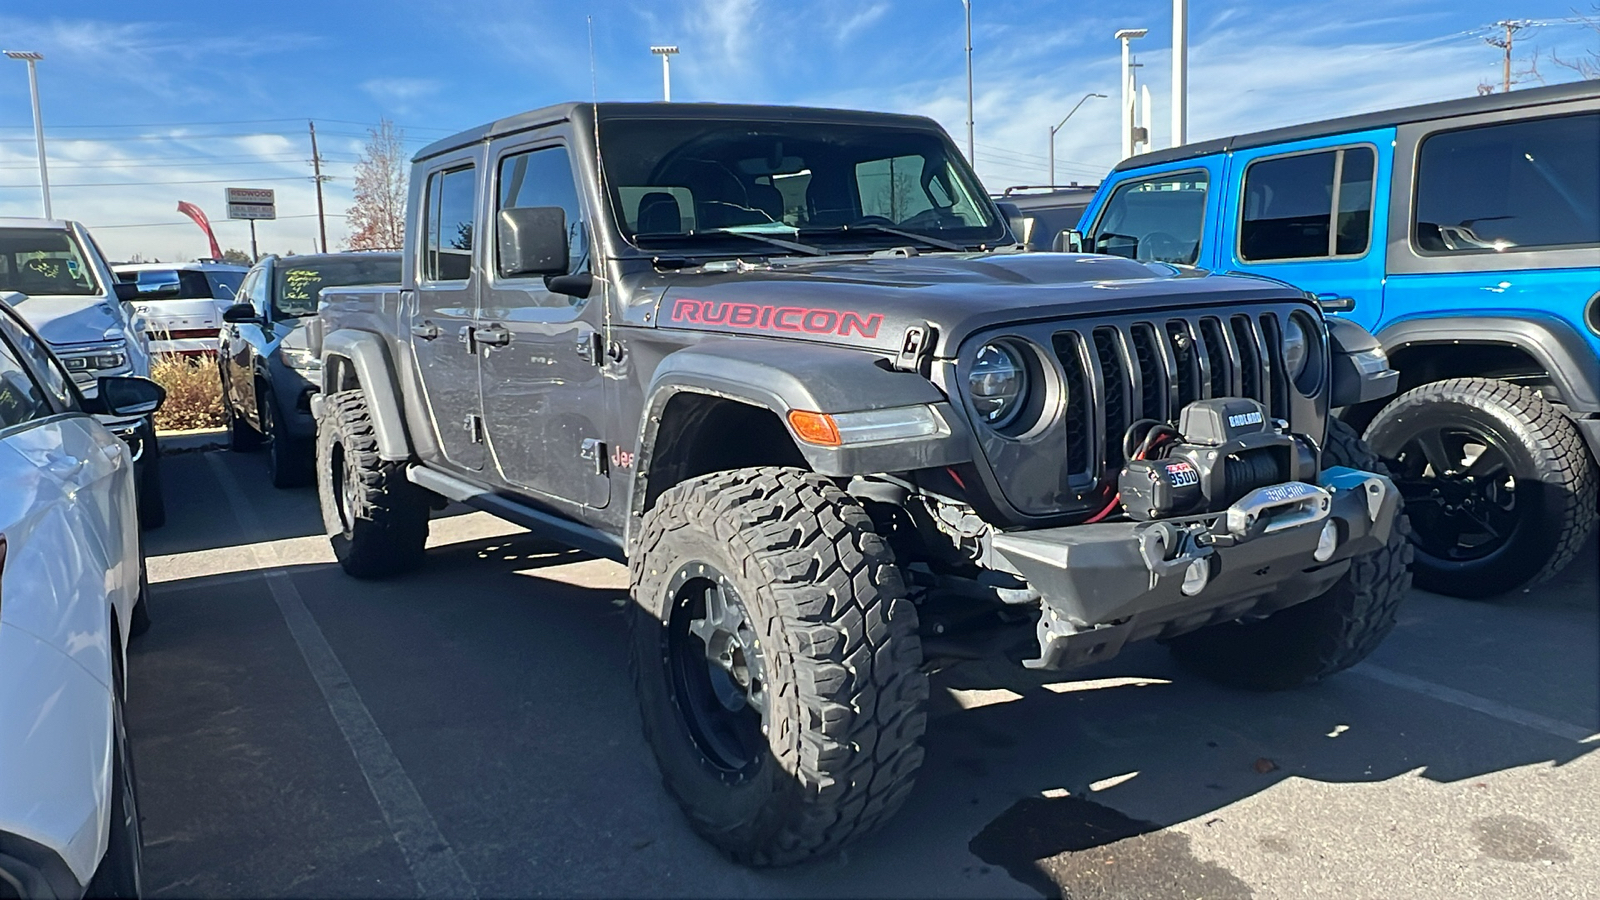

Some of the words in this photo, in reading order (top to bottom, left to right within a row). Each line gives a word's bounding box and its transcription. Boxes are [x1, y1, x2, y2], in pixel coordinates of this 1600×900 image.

[671, 298, 885, 339] RUBICON
[1228, 412, 1262, 428] BADLAND
[611, 445, 635, 468] Jee
[1169, 470, 1199, 487] 9500
